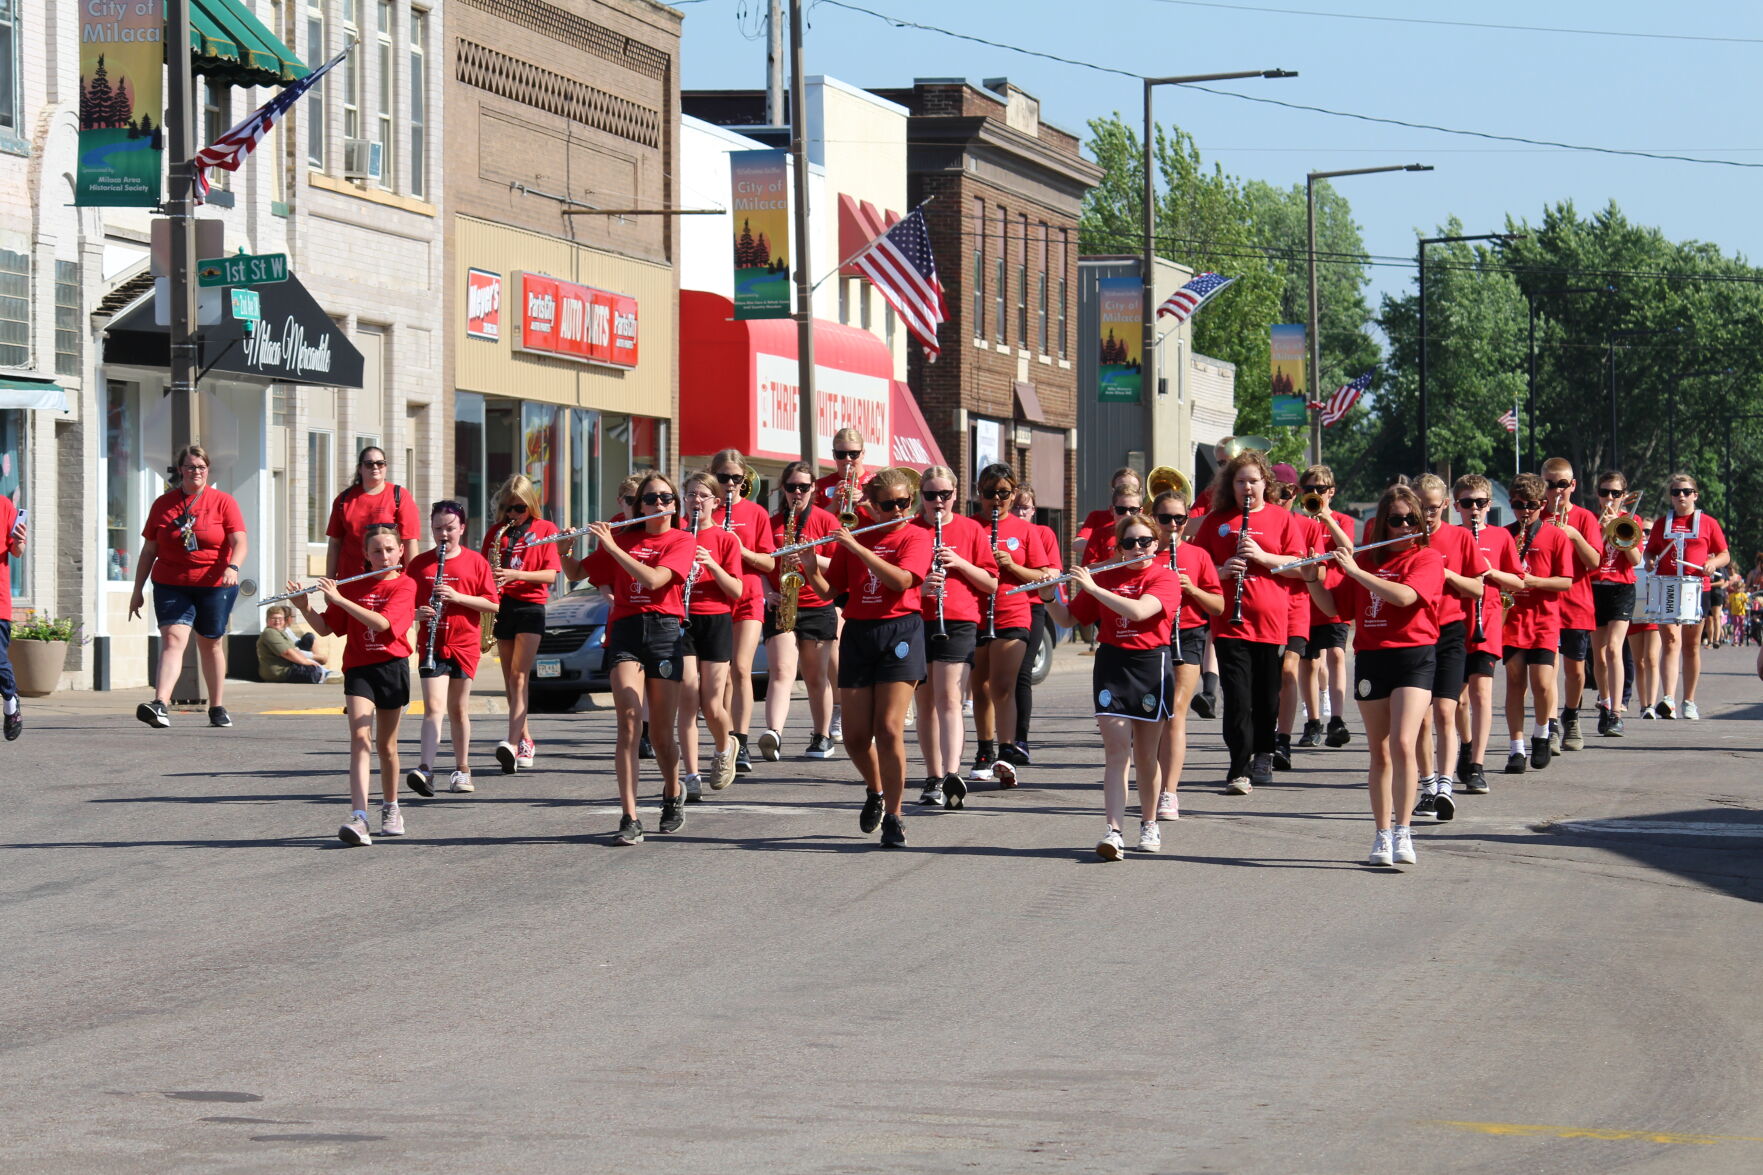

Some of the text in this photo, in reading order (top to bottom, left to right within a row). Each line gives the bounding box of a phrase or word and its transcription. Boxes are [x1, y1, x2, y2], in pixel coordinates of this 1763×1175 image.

[88, 0, 127, 20] City
[83, 22, 160, 43] Milaca
[124, 185, 149, 193] Society
[737, 179, 783, 196] City of
[734, 197, 787, 211] Milaca
[225, 257, 284, 283] 1st St W
[1103, 312, 1141, 322] Milaca
[1104, 301, 1124, 313] City
[560, 297, 610, 347] AUTO PARTS
[282, 315, 331, 376] Mercantile
[770, 381, 801, 432] THRIF
[841, 395, 886, 446] PHARMACY
[1666, 584, 1675, 613] YAMAHA
